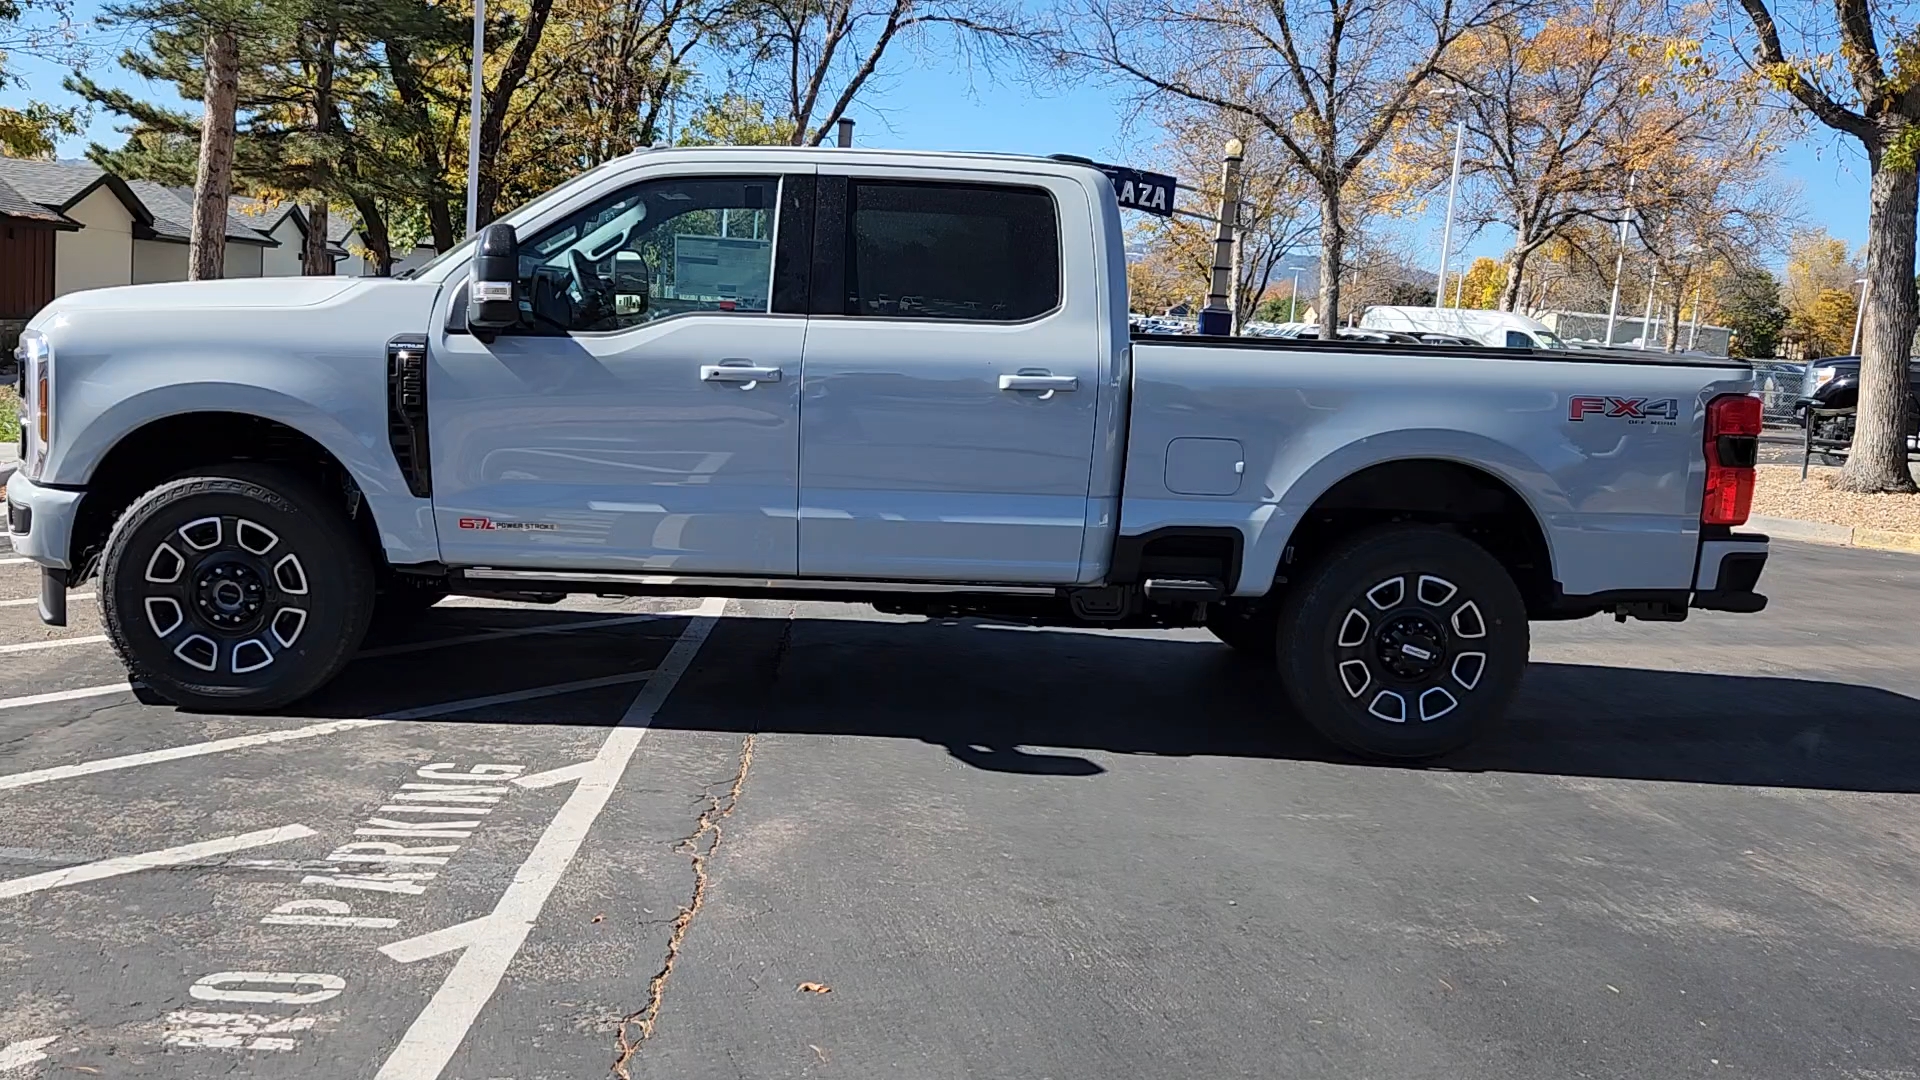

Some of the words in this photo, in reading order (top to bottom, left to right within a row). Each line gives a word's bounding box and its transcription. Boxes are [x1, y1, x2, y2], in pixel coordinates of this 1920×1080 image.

[1112, 179, 1167, 210] AZA
[1568, 394, 1679, 422] FX4
[496, 522, 523, 530] POWER
[524, 522, 556, 531] STROKE
[161, 971, 347, 1051] NO
[259, 762, 527, 929] PARKING
